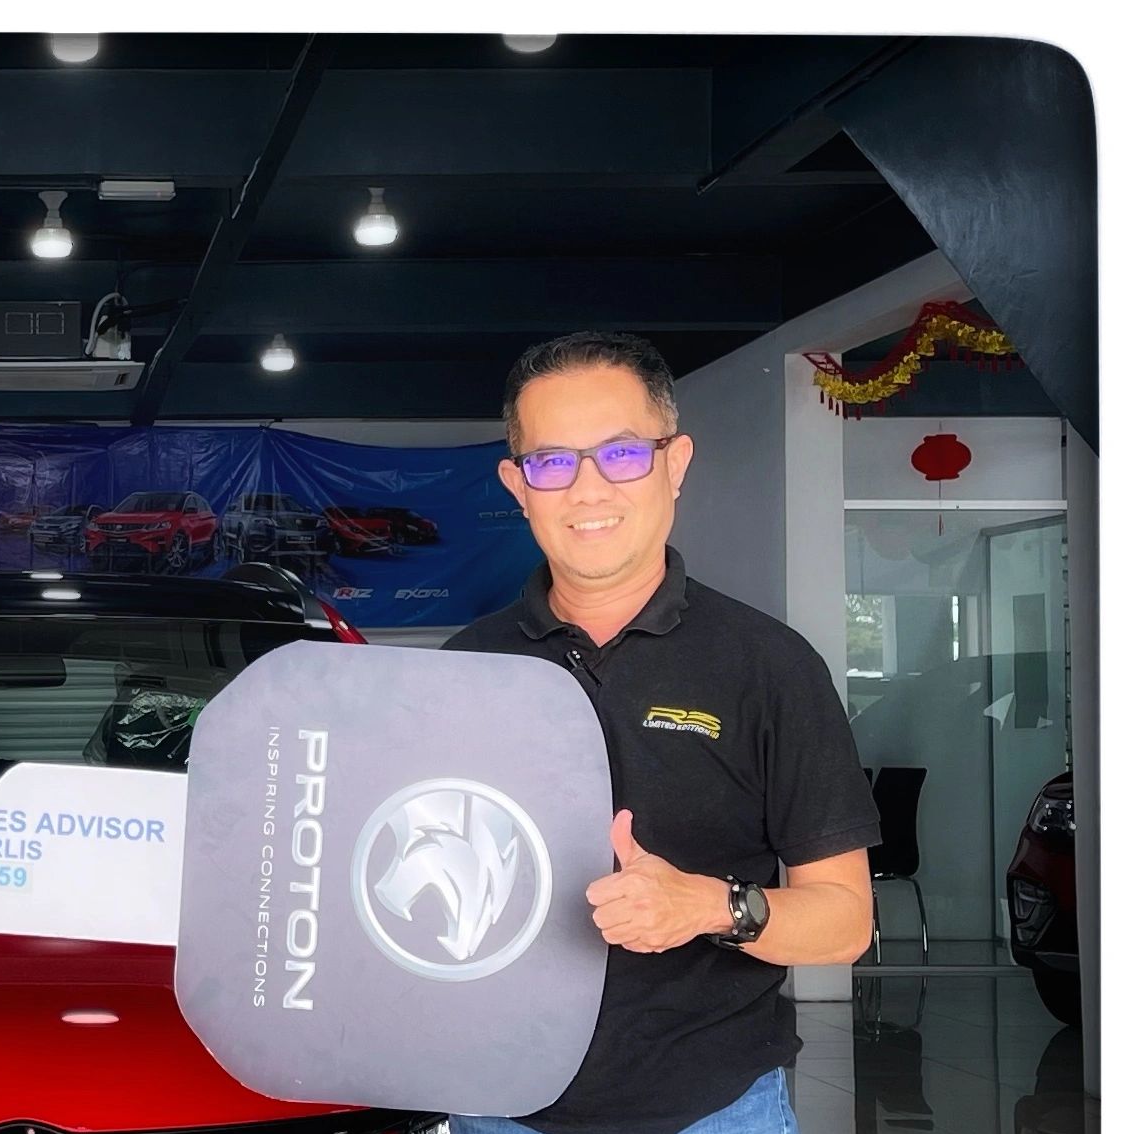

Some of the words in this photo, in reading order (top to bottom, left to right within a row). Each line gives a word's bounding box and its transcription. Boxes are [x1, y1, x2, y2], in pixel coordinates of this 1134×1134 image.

[394, 588, 449, 600] EXORA
[35, 812, 165, 843] ADVISOR
[263, 726, 280, 836] INSPIRING
[282, 729, 329, 1010] PROTON
[253, 844, 274, 1008] CONNECTIONS
